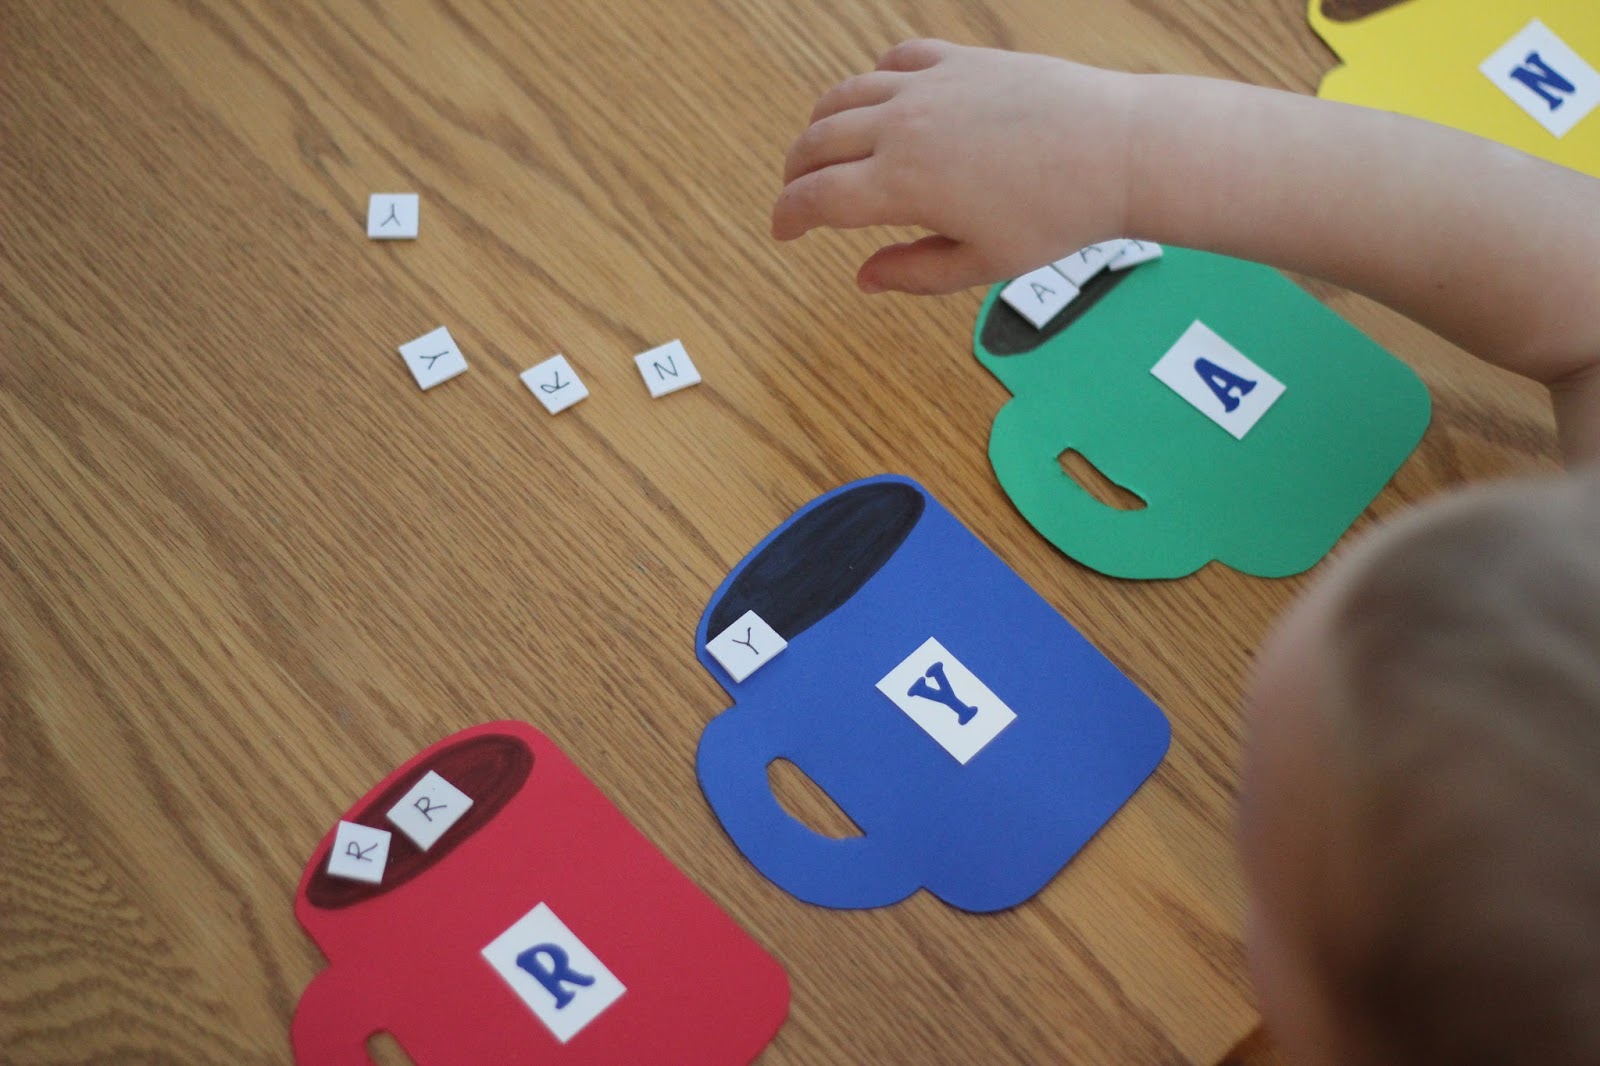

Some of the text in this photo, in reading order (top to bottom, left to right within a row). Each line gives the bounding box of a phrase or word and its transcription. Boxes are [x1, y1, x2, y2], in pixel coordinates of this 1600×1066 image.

[1509, 50, 1576, 111] N
[380, 202, 401, 228] Y
[1030, 281, 1056, 304] A
[419, 351, 449, 370] Y
[653, 355, 679, 380] N
[540, 371, 570, 394] R
[1194, 356, 1258, 413] A
[731, 627, 759, 655] Y
[907, 661, 979, 726] Y
[413, 796, 448, 822] R
[346, 840, 379, 862] R
[515, 942, 597, 1010] R
